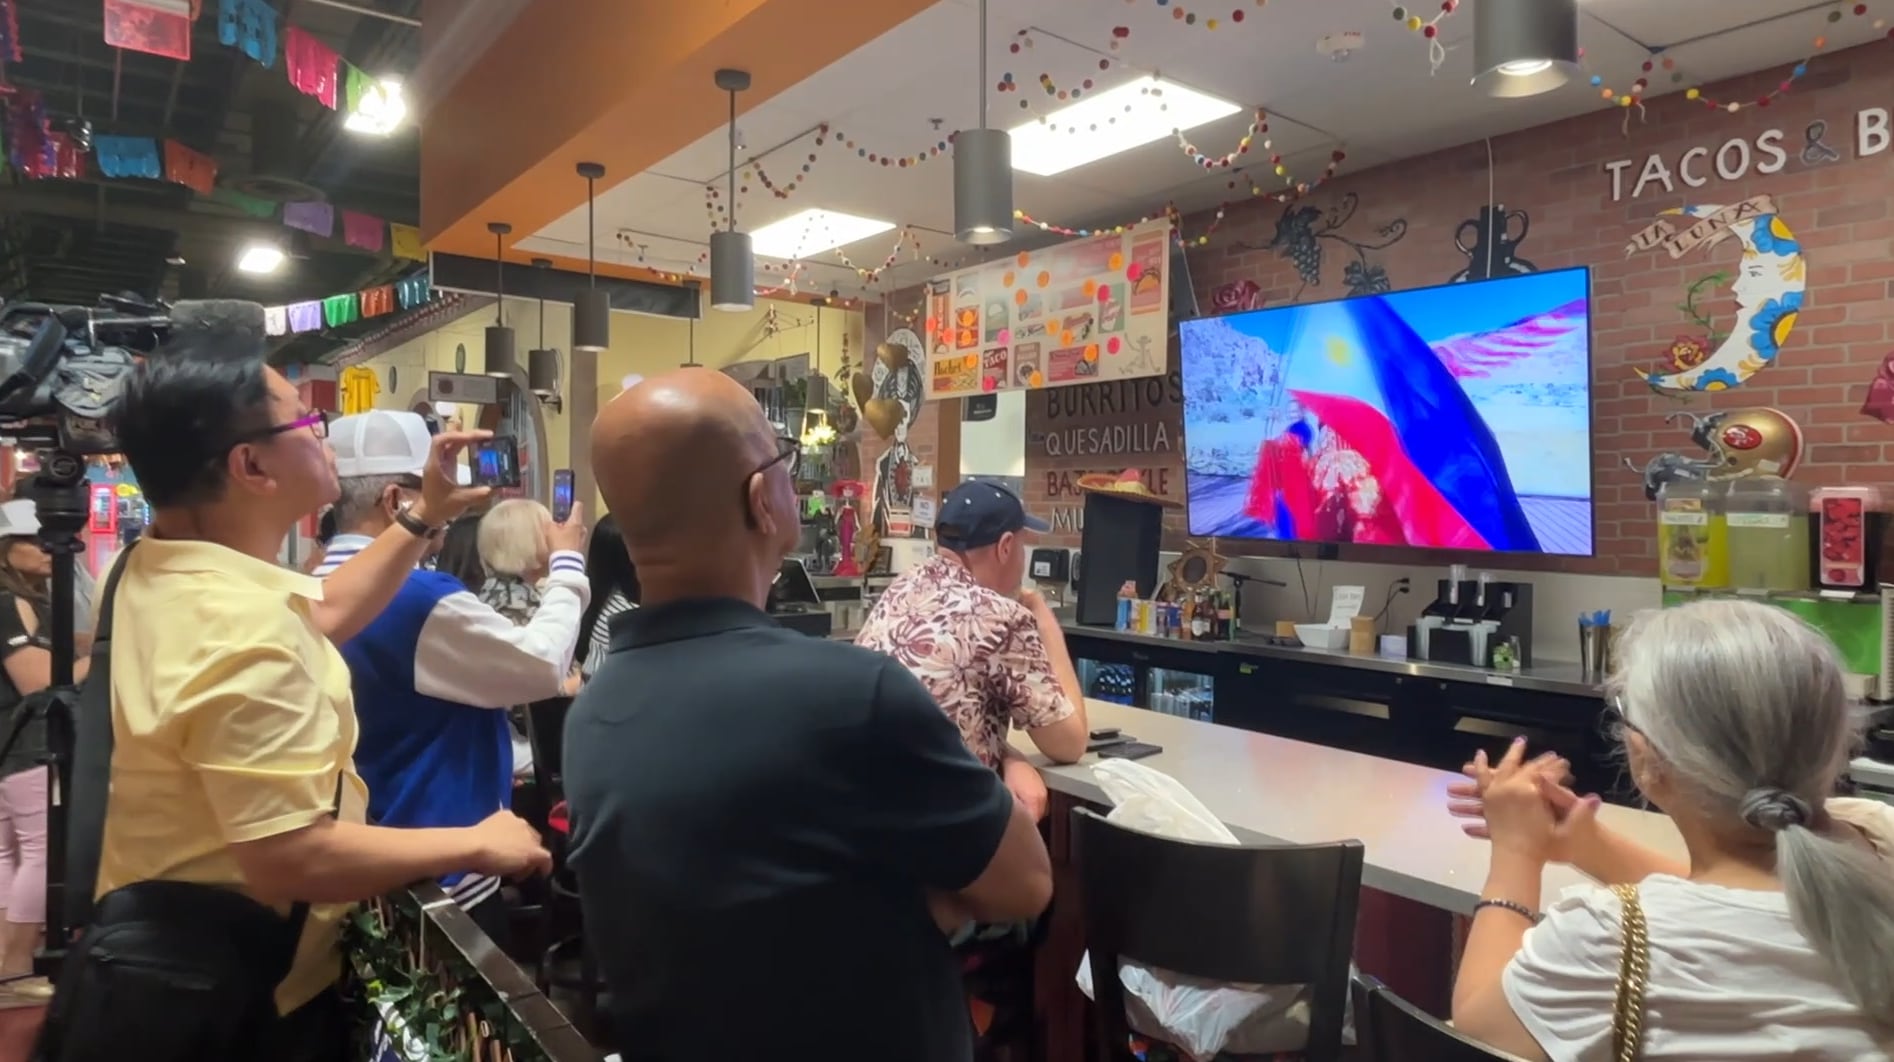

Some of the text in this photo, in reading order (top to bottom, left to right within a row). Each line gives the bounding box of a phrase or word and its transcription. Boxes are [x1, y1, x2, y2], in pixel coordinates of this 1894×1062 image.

[1605, 128, 1787, 201] TACOS
[1800, 119, 1840, 166] &
[1673, 200, 1762, 253] LUNA
[1047, 370, 1182, 419] BURRITOS
[1045, 421, 1170, 456] QUESADILLA
